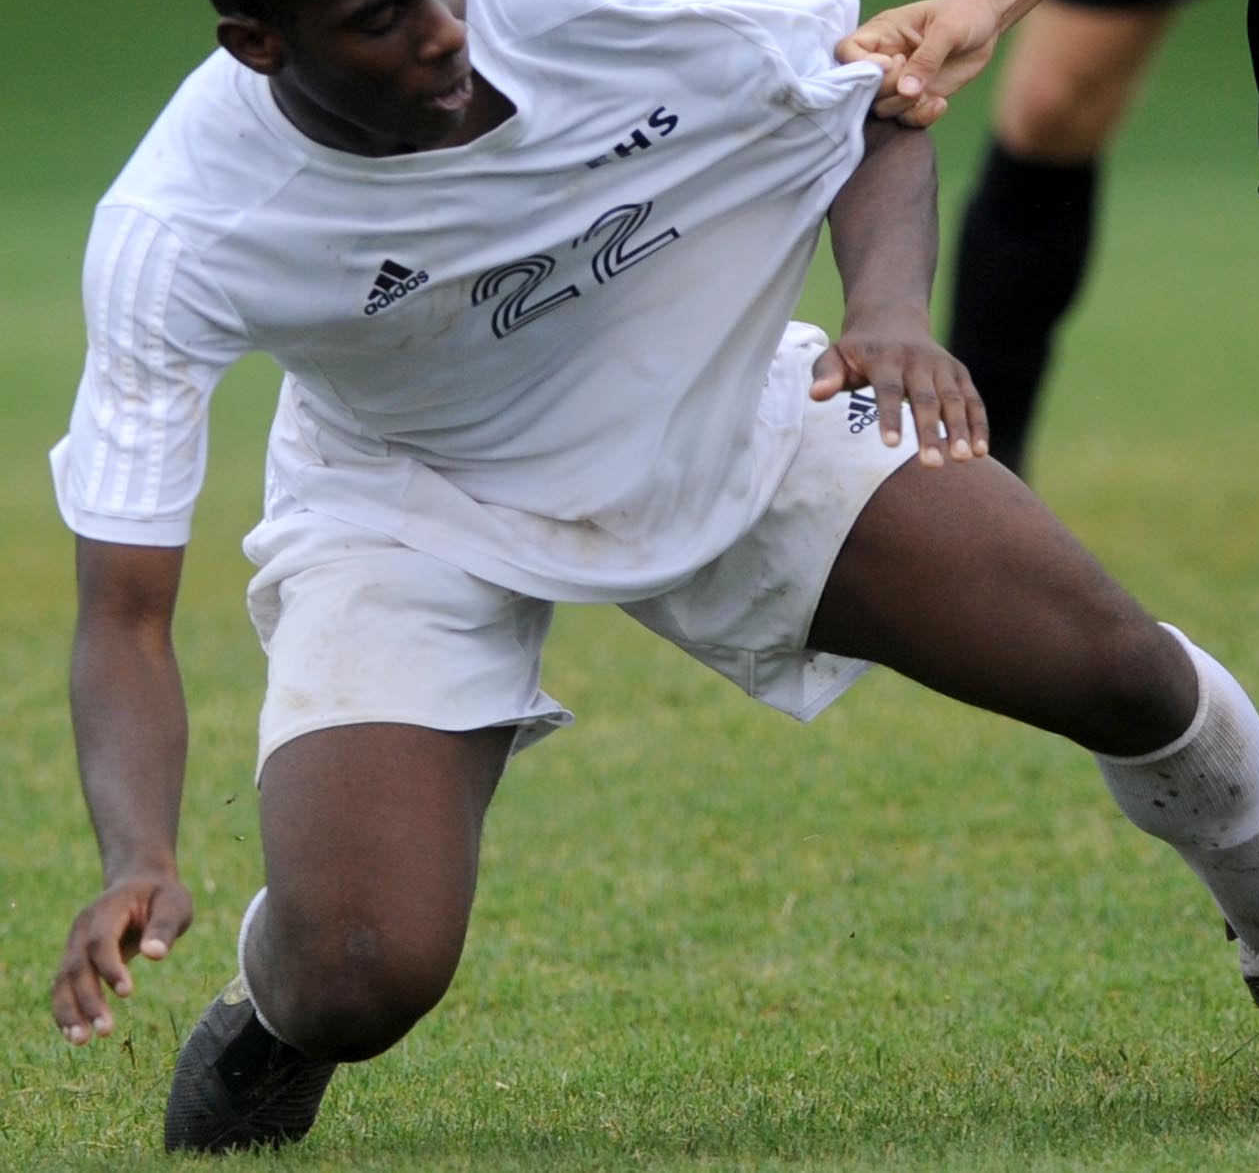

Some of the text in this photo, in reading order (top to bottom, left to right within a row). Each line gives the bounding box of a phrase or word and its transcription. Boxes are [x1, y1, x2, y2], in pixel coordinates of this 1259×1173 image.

[364, 270, 430, 316] adidas
[471, 201, 681, 340] 22
[849, 409, 880, 434] adi
